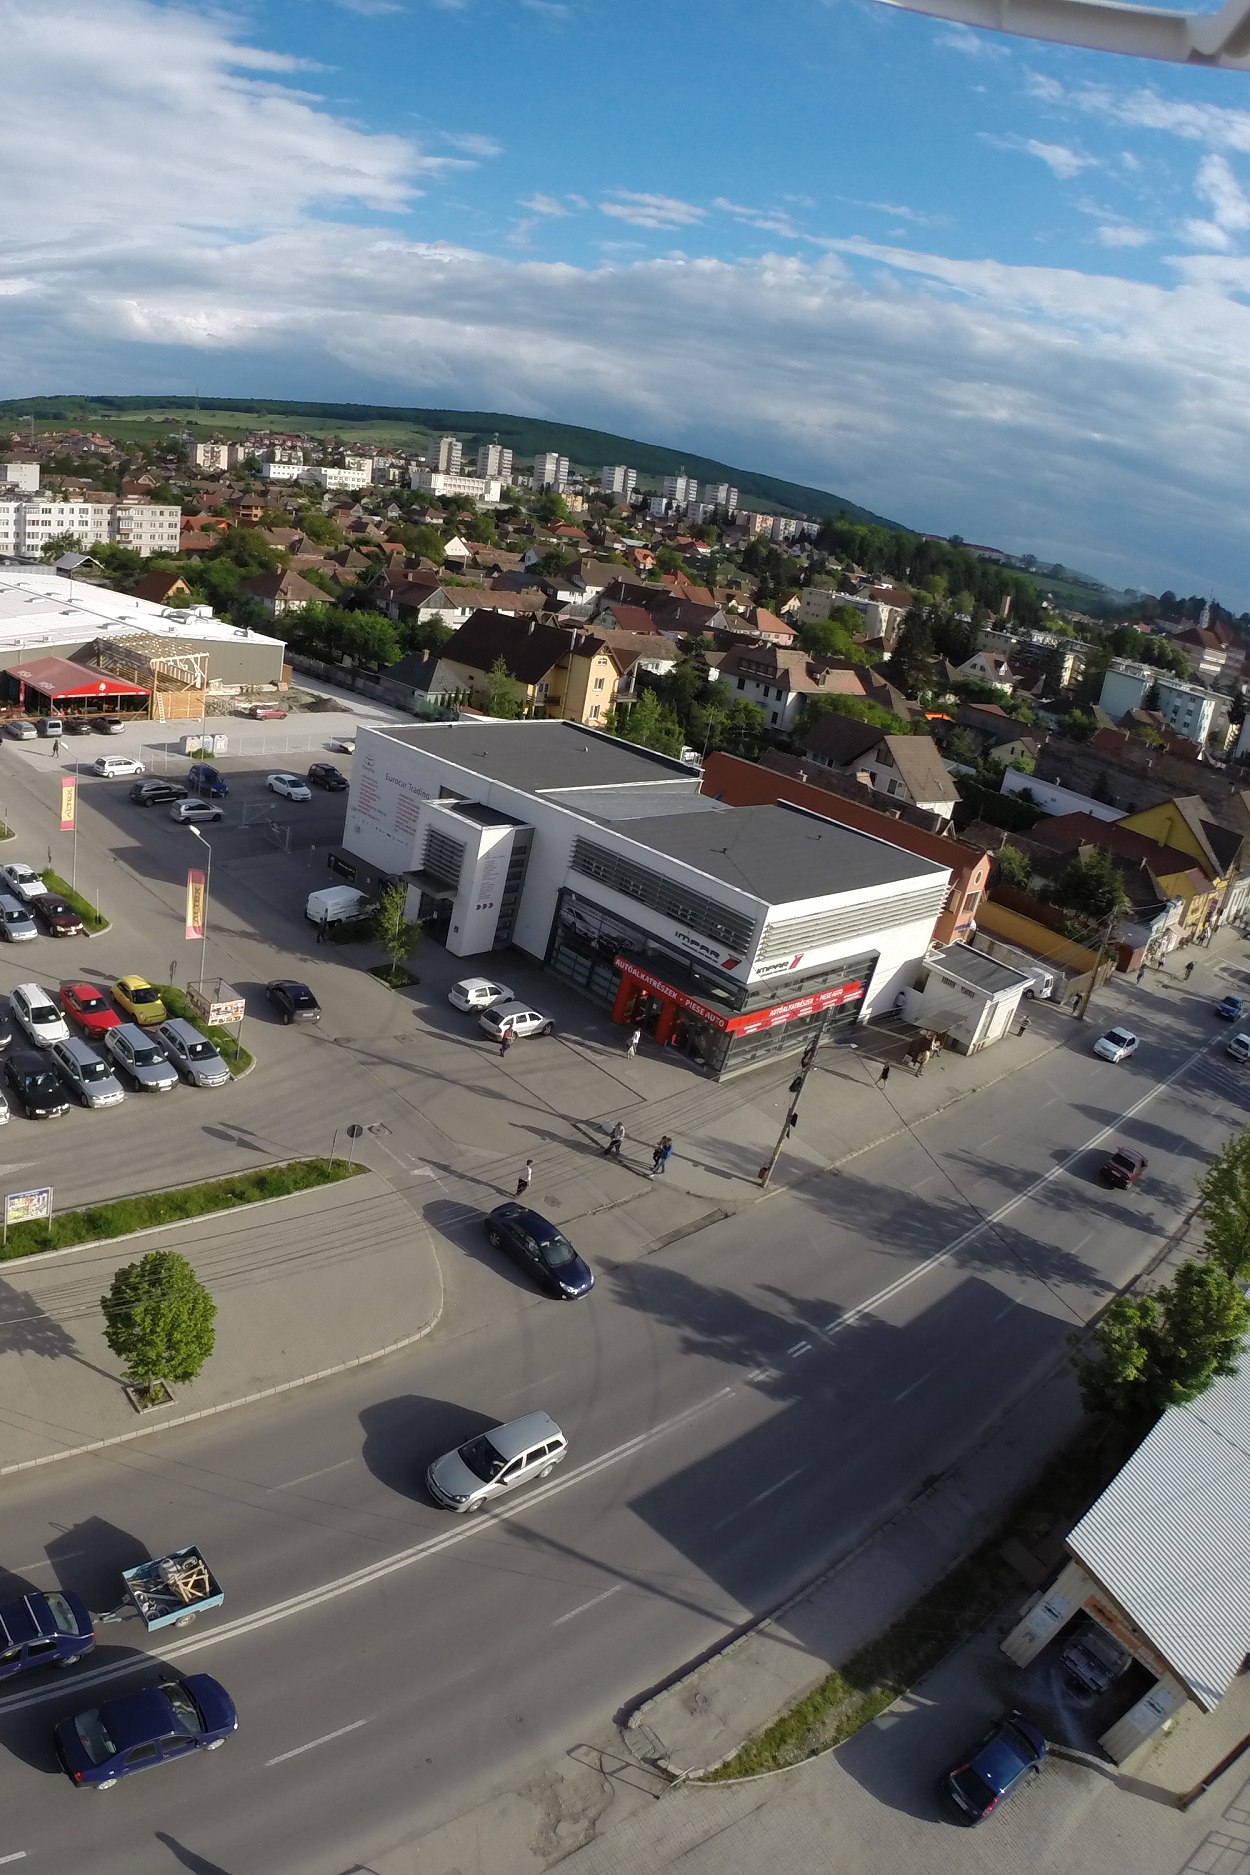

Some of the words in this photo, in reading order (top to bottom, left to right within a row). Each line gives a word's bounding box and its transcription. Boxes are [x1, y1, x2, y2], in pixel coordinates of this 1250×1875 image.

[385, 772, 407, 788] Eurocar
[408, 782, 430, 800] Trading
[615, 958, 678, 1000] AUTÓALKATRÉSZEK
[685, 999, 704, 1016] PIESE
[704, 1011, 725, 1027] AUTO
